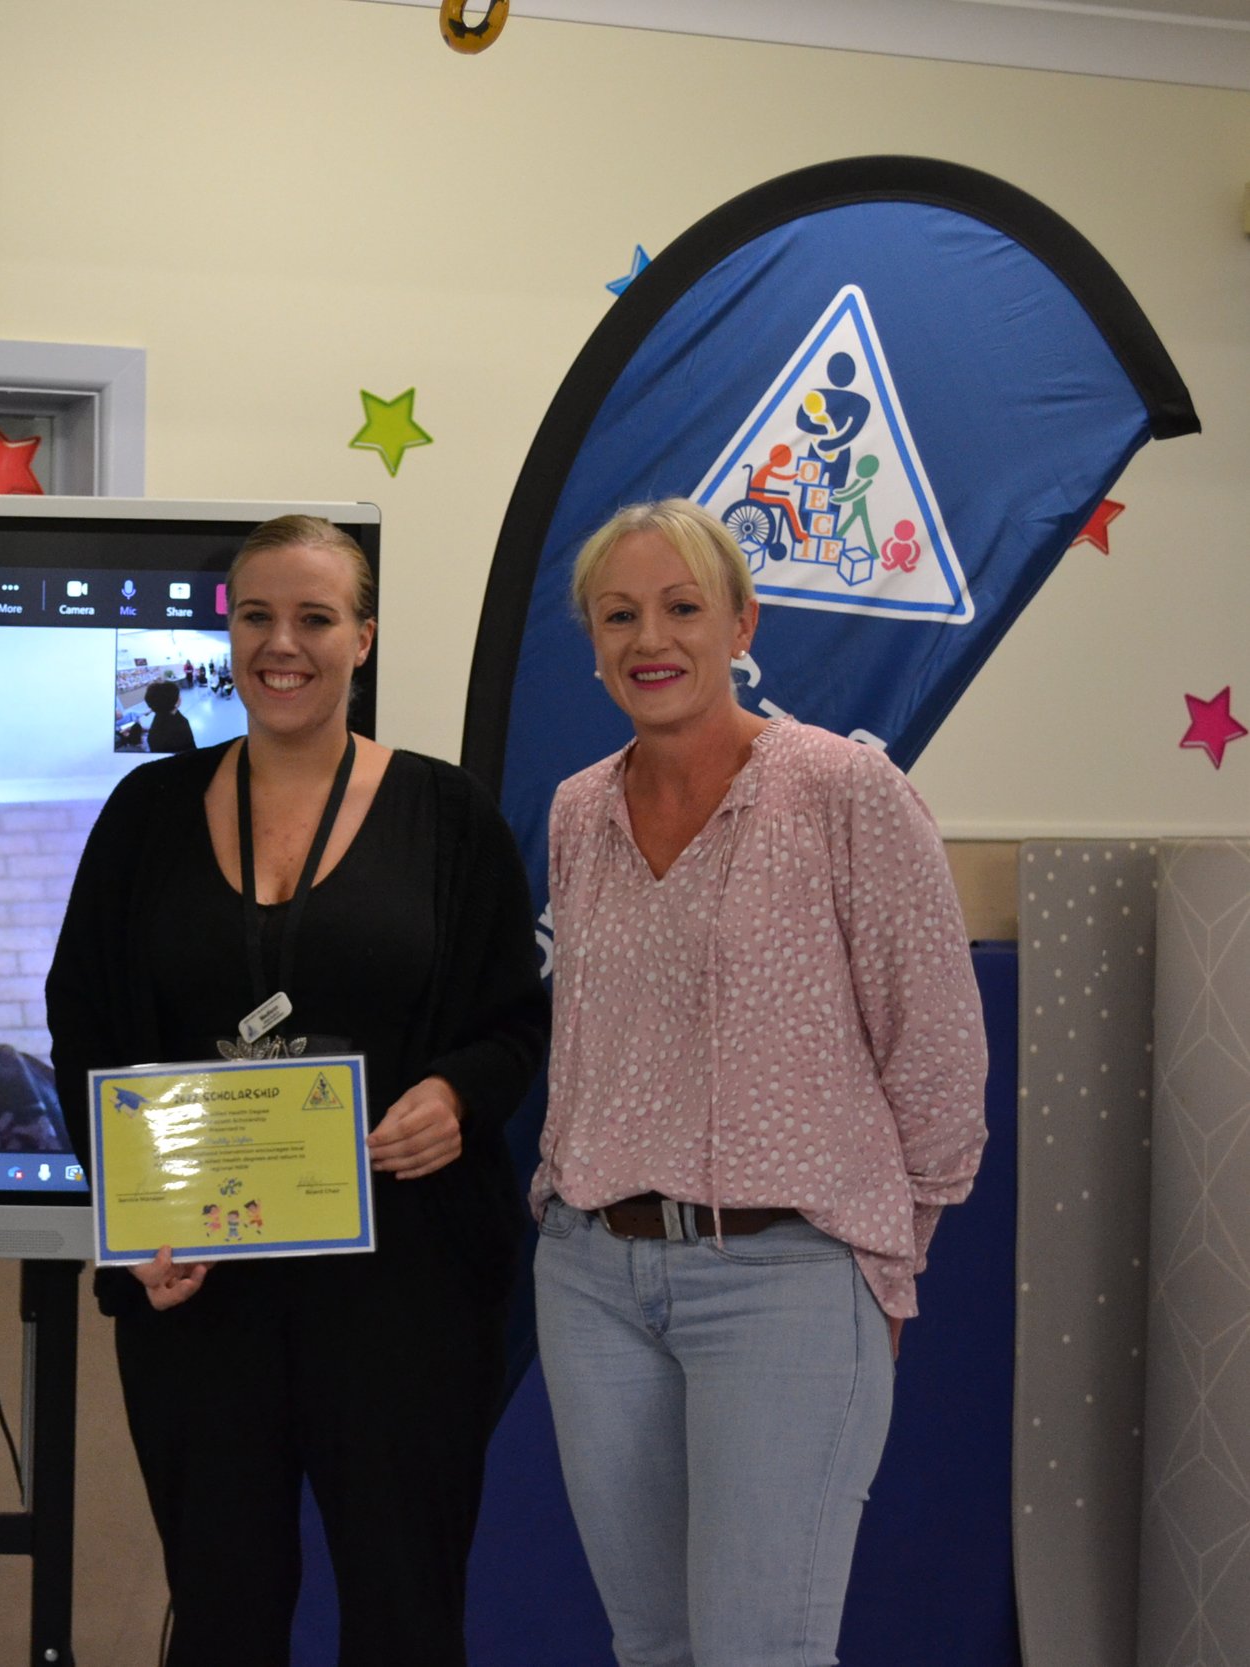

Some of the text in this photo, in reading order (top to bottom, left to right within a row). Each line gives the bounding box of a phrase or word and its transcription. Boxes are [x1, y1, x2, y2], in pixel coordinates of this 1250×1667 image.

[58, 604, 96, 616] Camera
[119, 606, 137, 617] Mic
[165, 606, 194, 618] Share
[203, 1087, 280, 1101] SCHOLARSHIP
